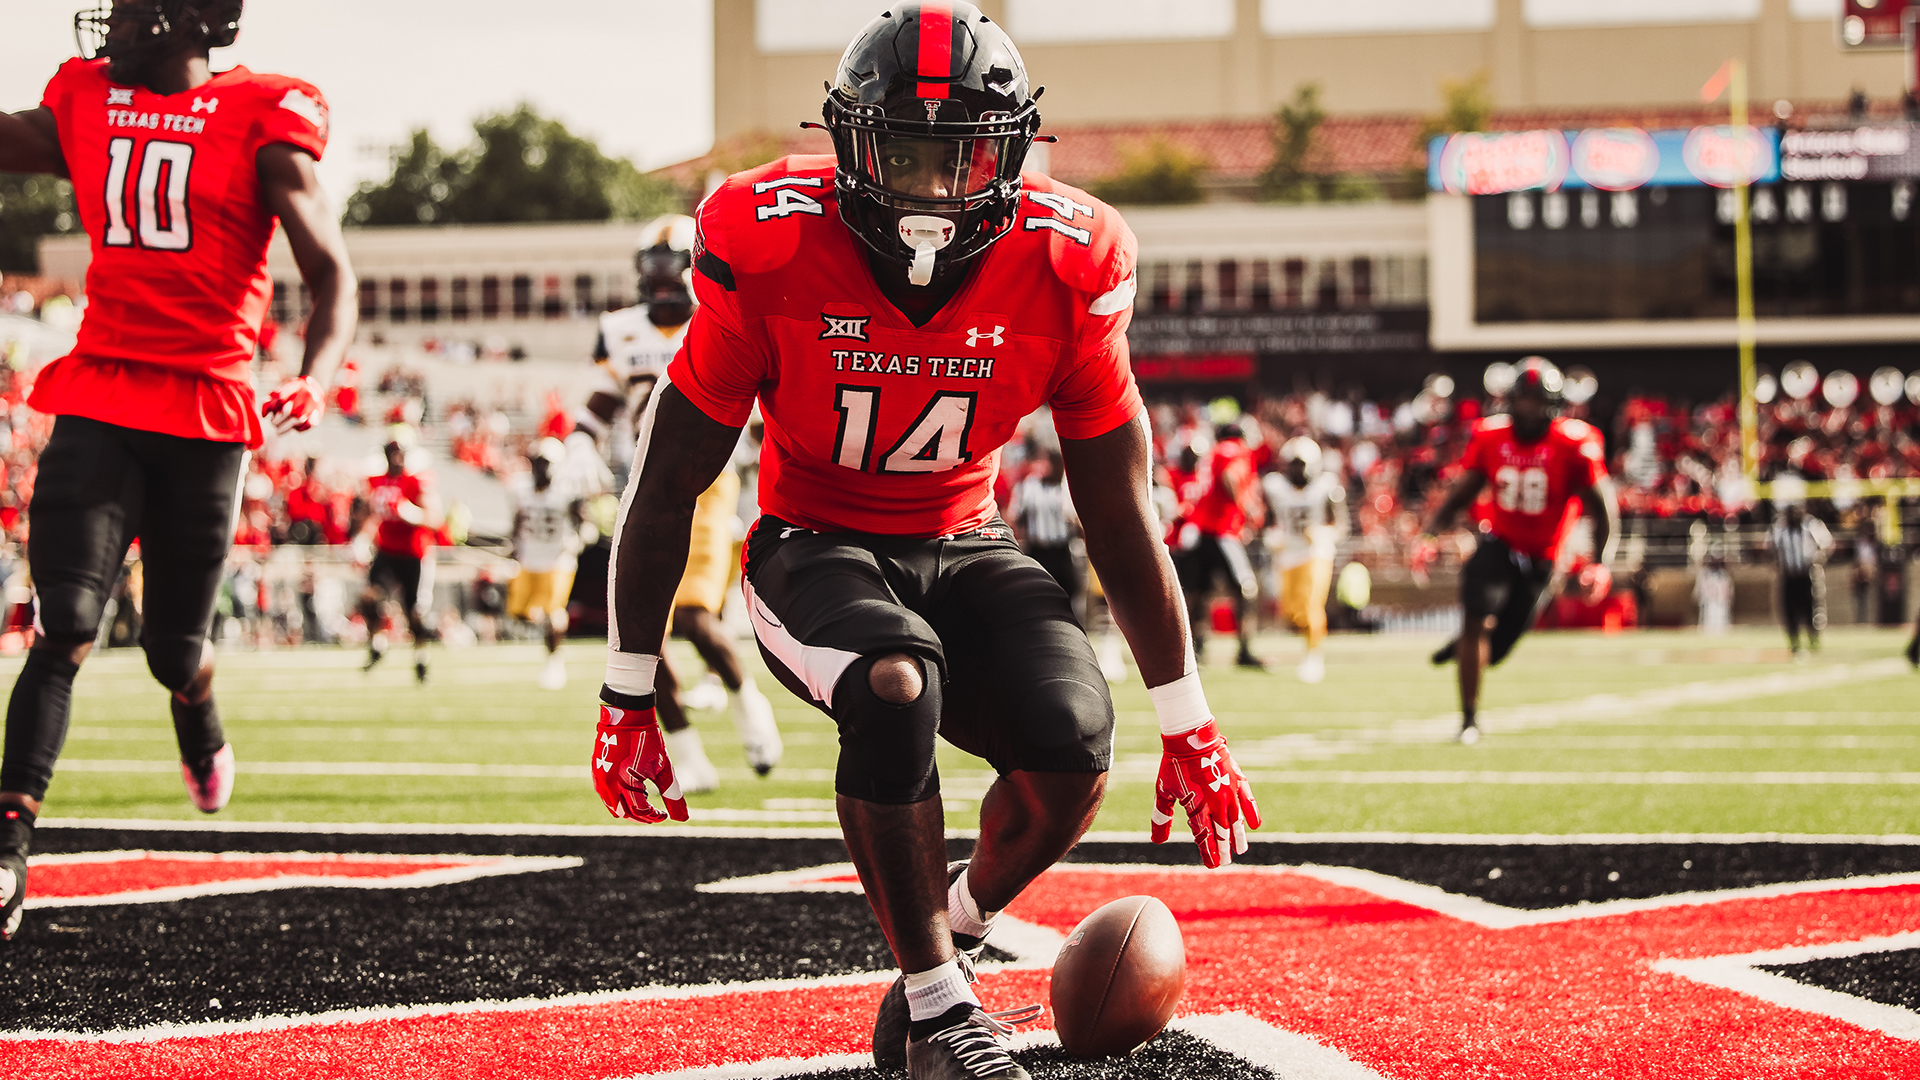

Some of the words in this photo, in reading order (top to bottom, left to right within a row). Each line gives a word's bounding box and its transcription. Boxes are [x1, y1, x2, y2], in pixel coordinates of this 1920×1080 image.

[107, 109, 160, 130] TEXAS
[163, 113, 206, 135] TECH
[103, 137, 195, 253] 10
[753, 176, 825, 222] 14
[1023, 191, 1094, 247] 14
[818, 312, 871, 343] XII
[831, 350, 921, 375] TEXAS
[926, 356, 995, 379] TECH
[831, 383, 978, 474] 14
